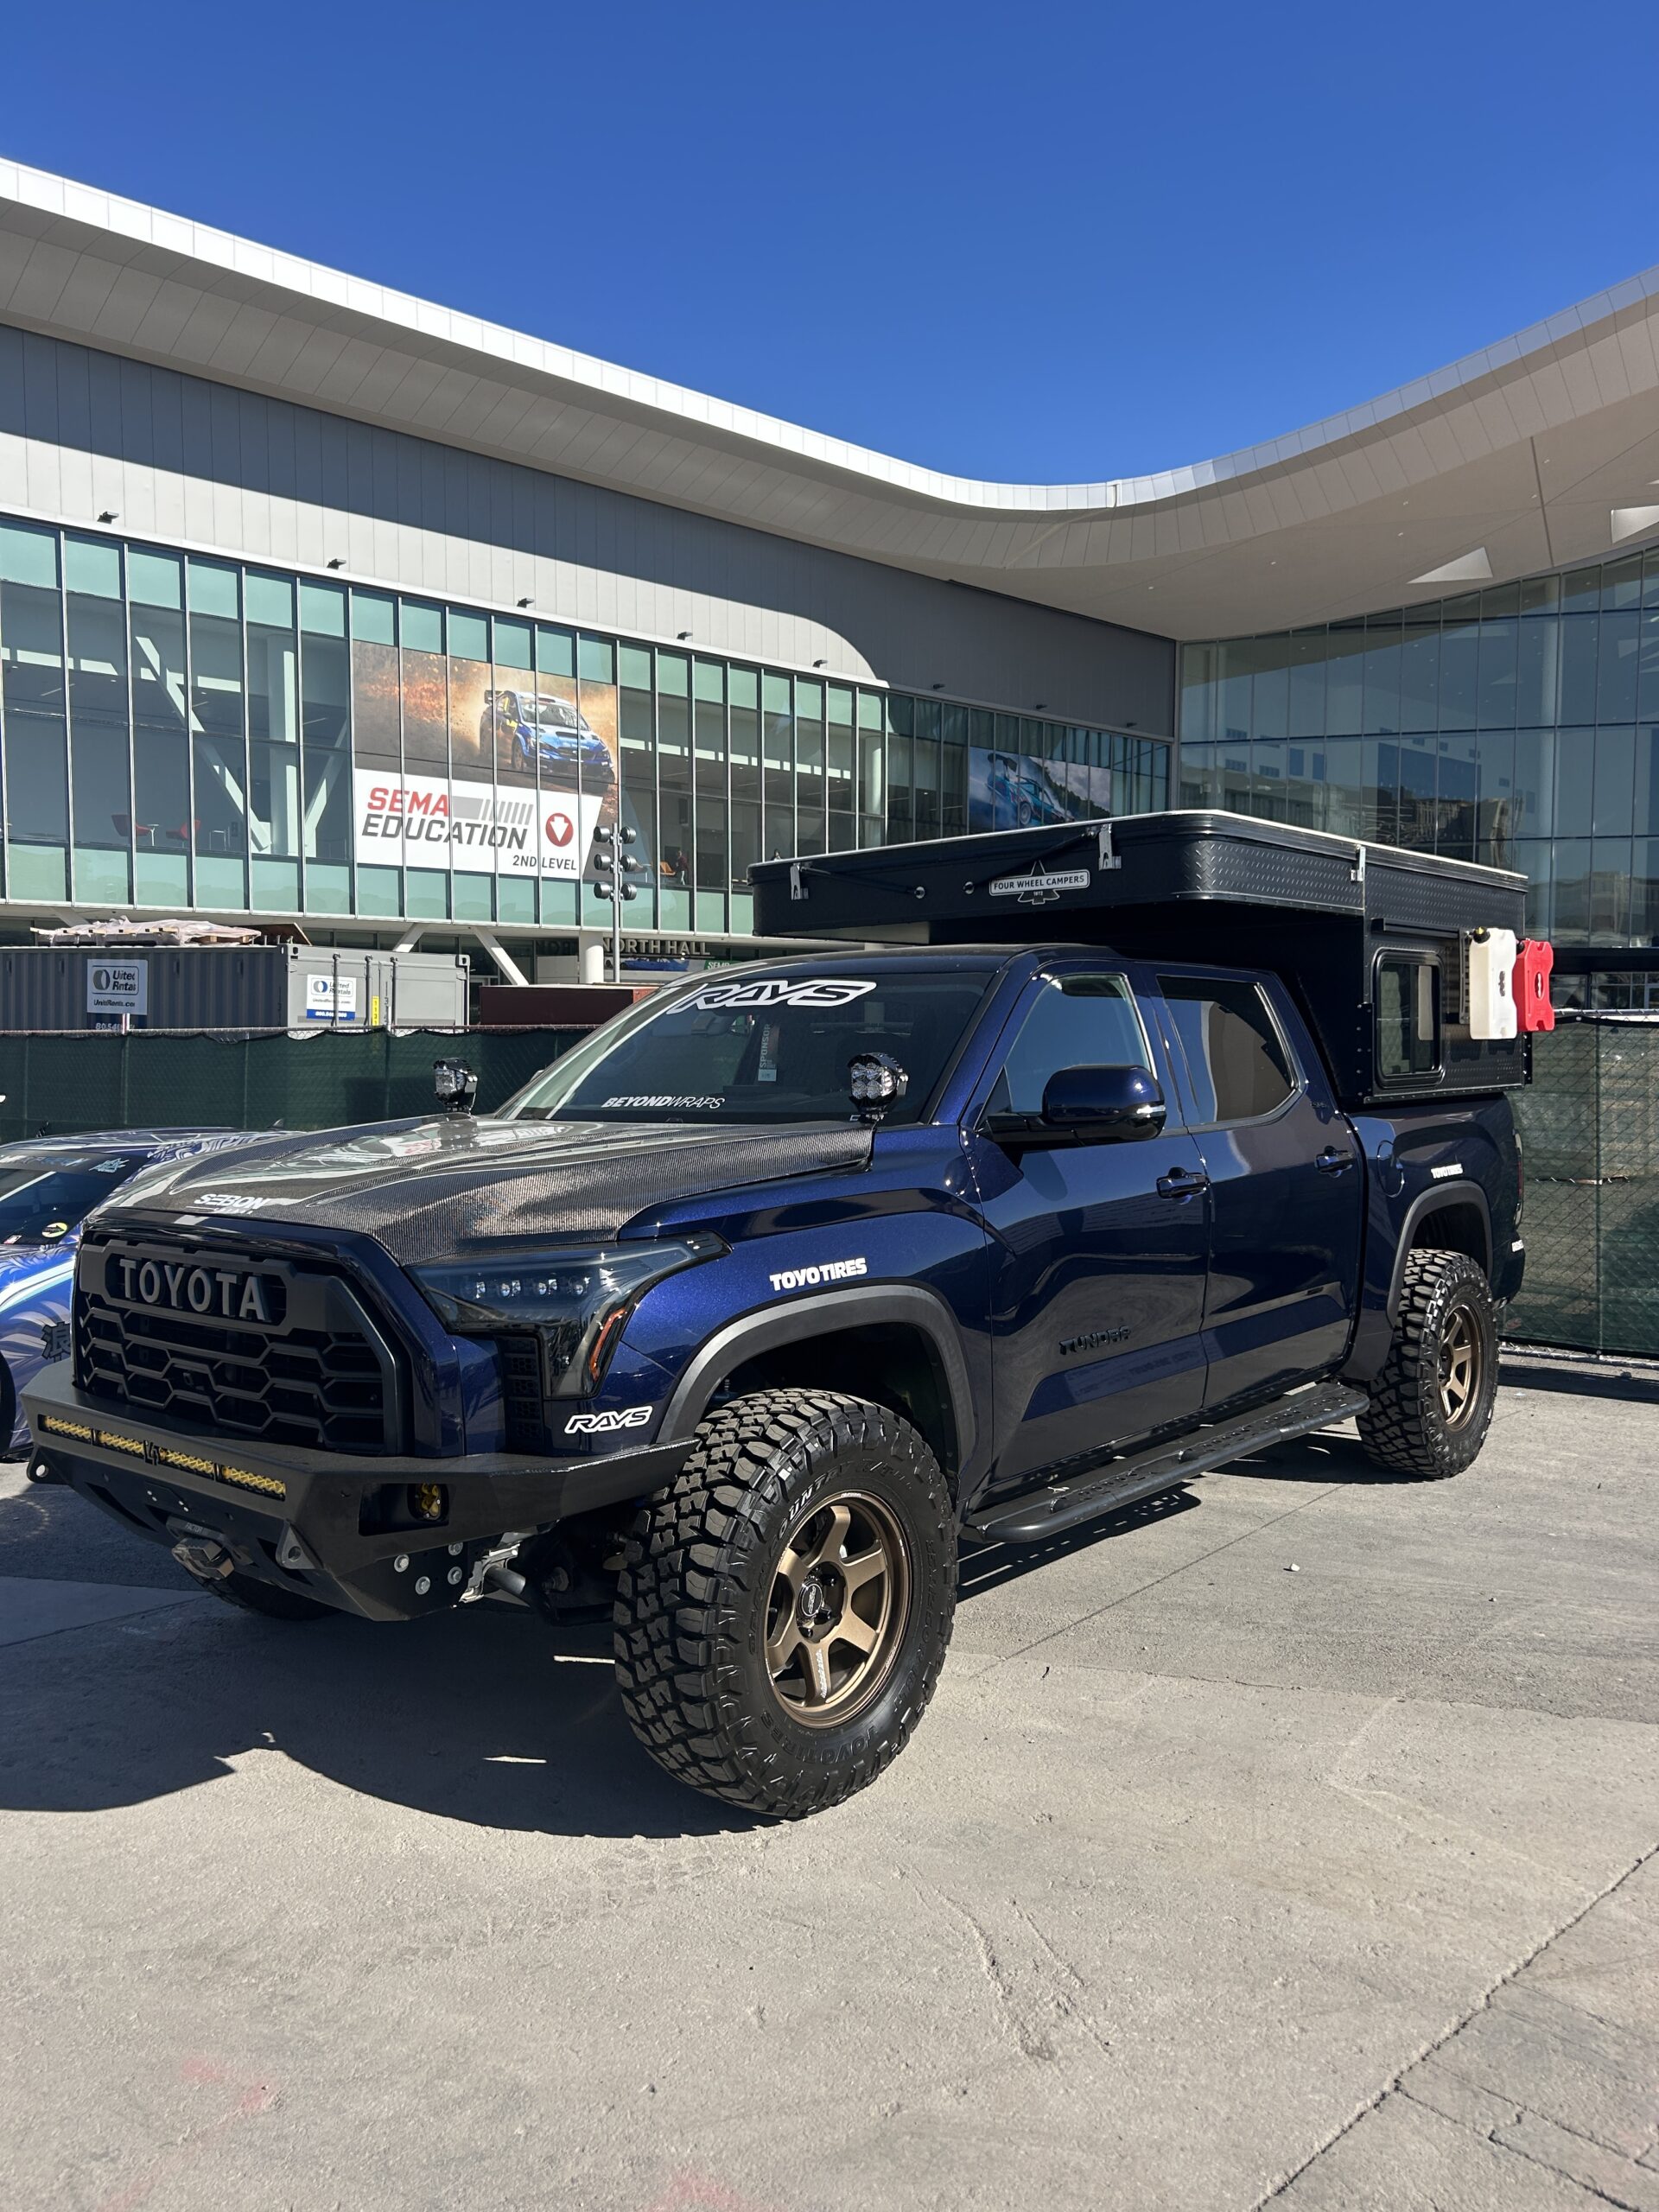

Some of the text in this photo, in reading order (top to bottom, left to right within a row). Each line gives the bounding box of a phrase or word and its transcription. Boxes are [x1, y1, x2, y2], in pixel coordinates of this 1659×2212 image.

[367, 787, 449, 817] SEMA
[361, 813, 528, 849] EDUCATION
[512, 855, 577, 870] 2ND LEVEL
[994, 874, 1084, 890] FOUR WHEEL CAMPERS
[603, 937, 711, 956] NORTH HALL
[666, 980, 876, 1014] RAYS
[760, 1024, 772, 1068] SPONSOR
[194, 1193, 263, 1210] SEBON
[119, 1258, 266, 1320] TOYOTA
[564, 1406, 652, 1433] RAYS
